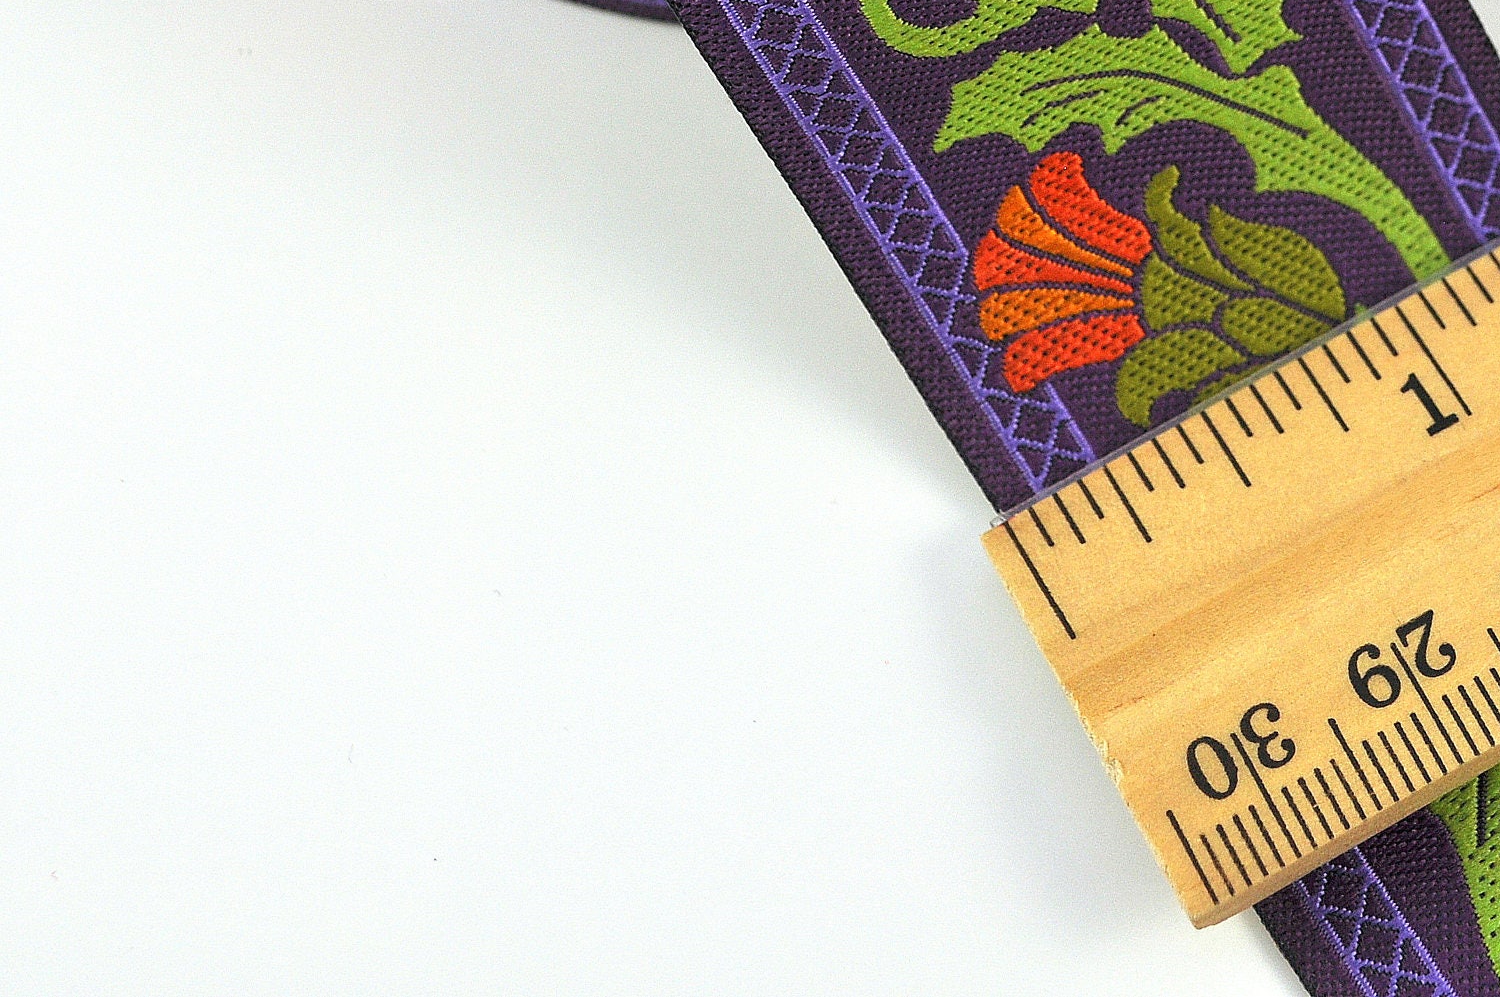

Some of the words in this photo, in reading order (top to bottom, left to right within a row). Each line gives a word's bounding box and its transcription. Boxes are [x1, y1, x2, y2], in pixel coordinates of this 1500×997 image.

[1400, 372, 1460, 437] 1
[1348, 610, 1456, 708] 29
[1186, 701, 1296, 800] 30
